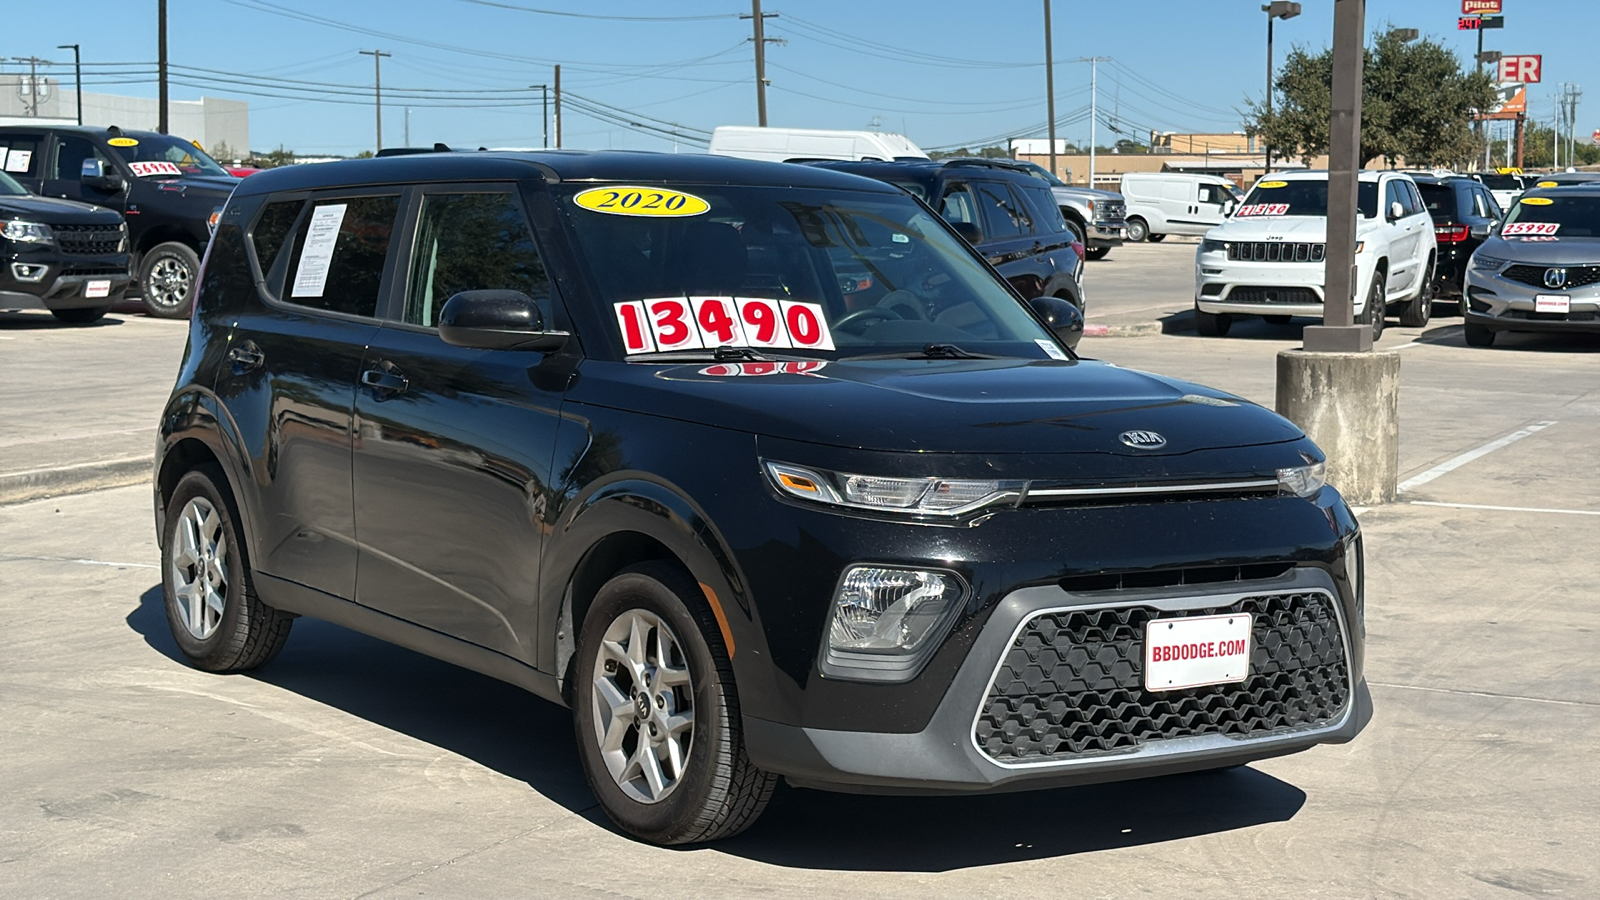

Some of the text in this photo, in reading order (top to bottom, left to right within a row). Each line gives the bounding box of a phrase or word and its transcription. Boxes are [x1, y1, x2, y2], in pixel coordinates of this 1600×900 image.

[1499, 57, 1539, 82] ER
[596, 191, 687, 211] 2020
[1503, 223, 1557, 234] 25990
[620, 299, 829, 350] 13490
[1124, 431, 1163, 444] KIA
[1152, 639, 1246, 662] BBDODGE.COM
